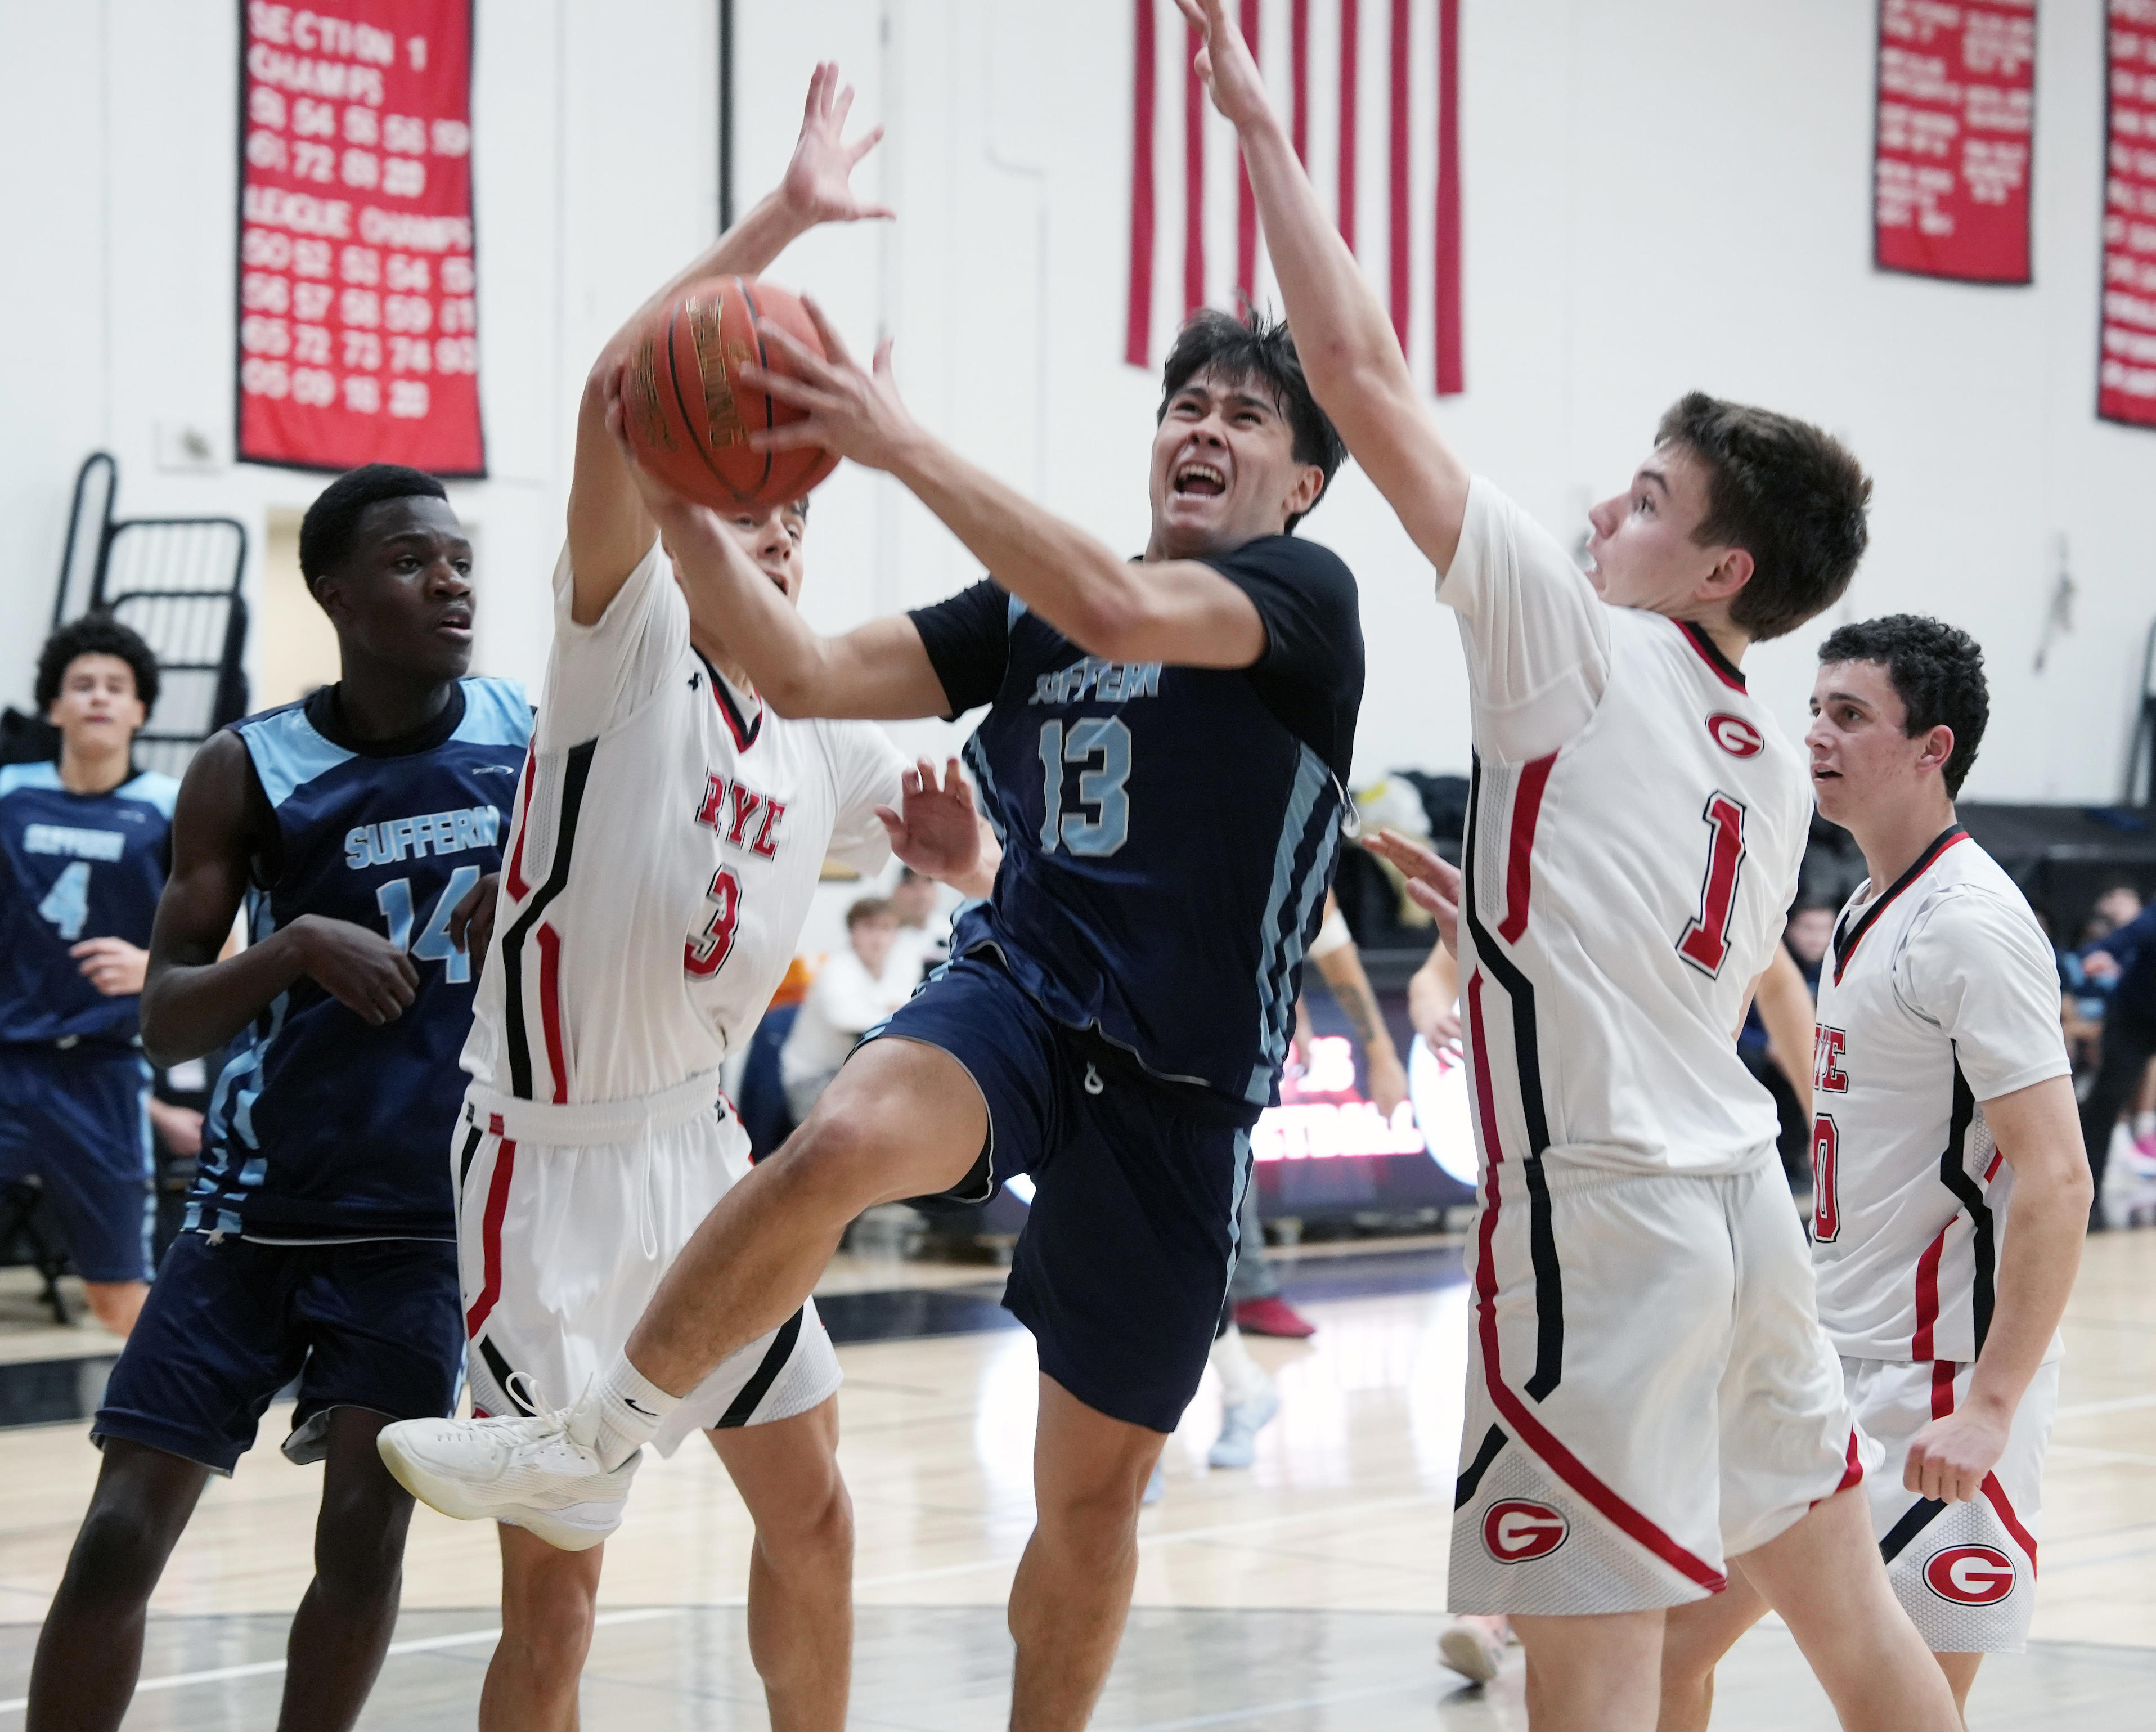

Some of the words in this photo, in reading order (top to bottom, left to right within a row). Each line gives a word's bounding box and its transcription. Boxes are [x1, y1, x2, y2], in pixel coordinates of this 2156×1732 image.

[248, 1, 395, 67] SECTION
[406, 34, 428, 72] 1
[248, 42, 384, 107] CHAMPS
[291, 140, 335, 183] 72
[243, 182, 353, 239] LEAGUE
[694, 772, 787, 863] RYE
[1039, 715, 1132, 858] 13
[344, 804, 501, 870] SUFFERN
[38, 861, 92, 941] 4
[684, 861, 742, 983] 3
[1675, 789, 1746, 981] 1
[376, 864, 481, 984] 14
[1813, 1113, 1840, 1242] 0
[1481, 1498, 1570, 1565] G
[1923, 1543, 2016, 1607] G
